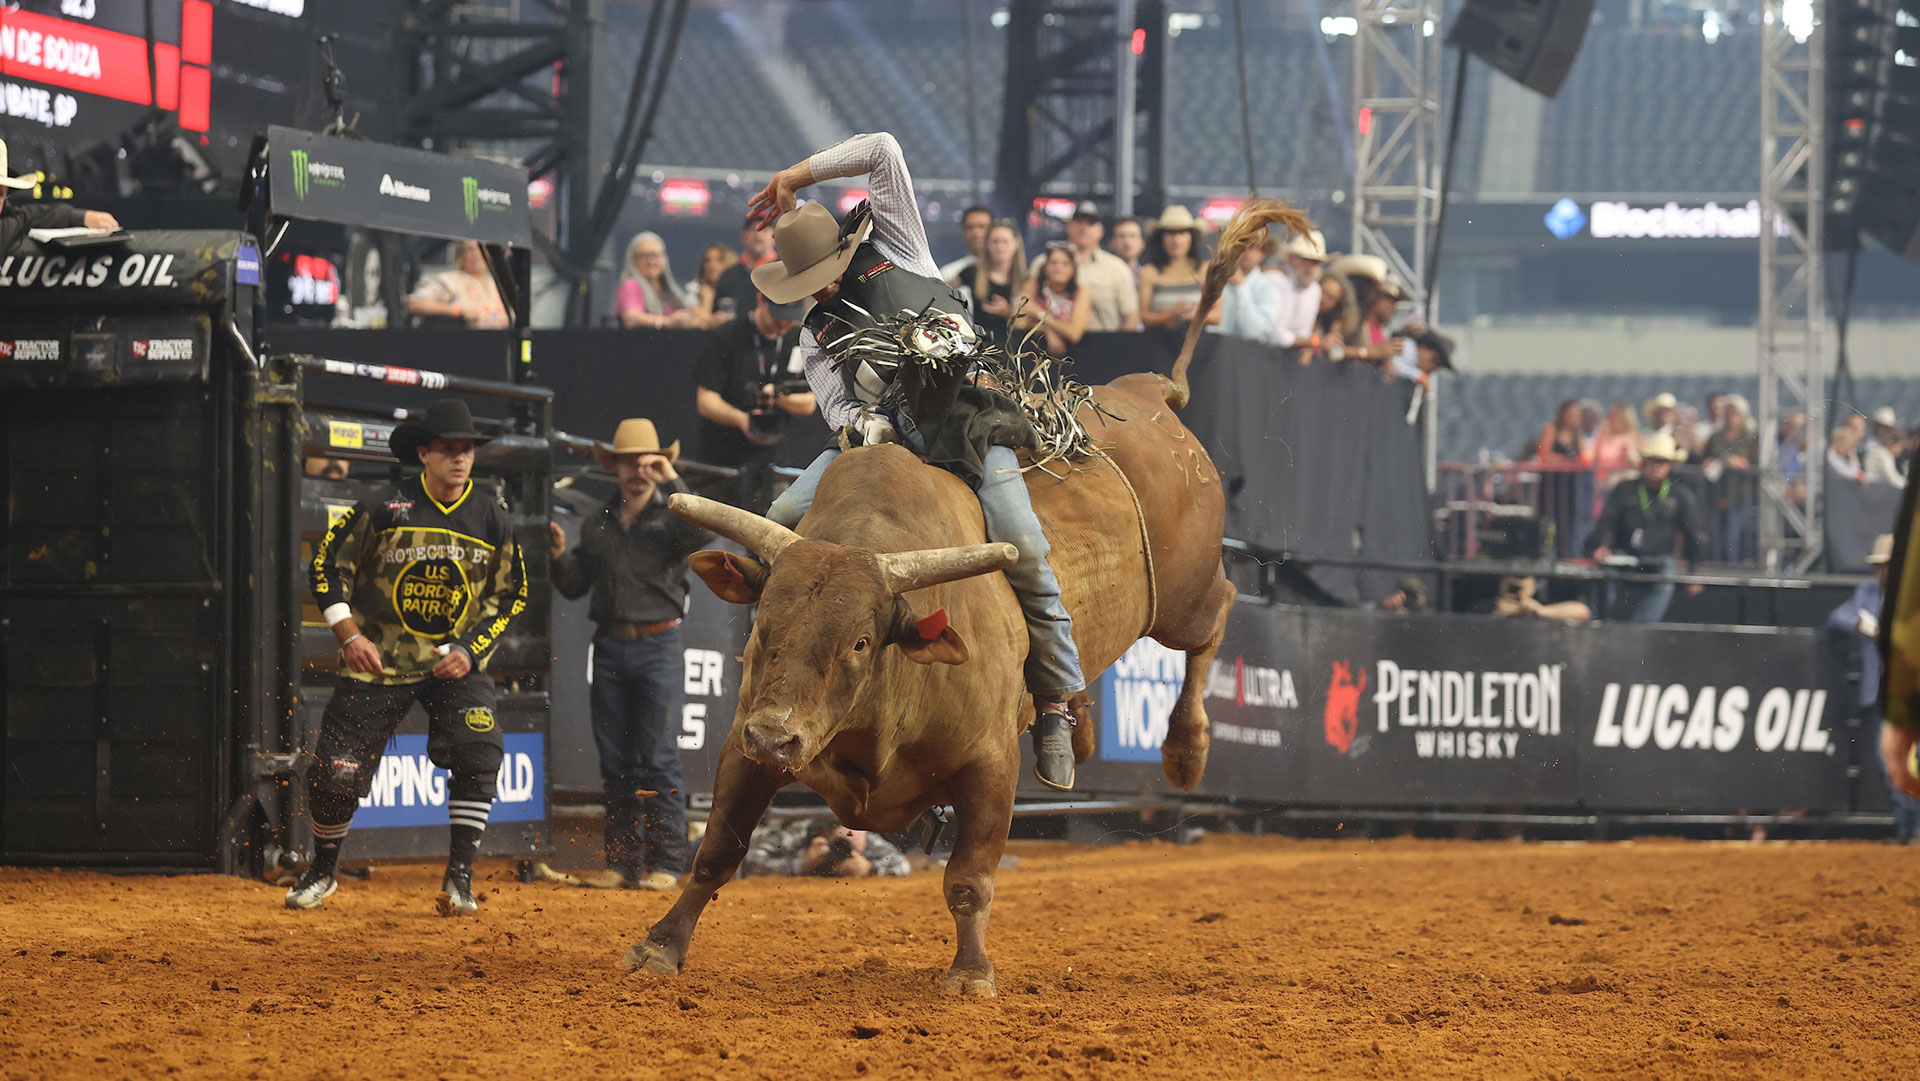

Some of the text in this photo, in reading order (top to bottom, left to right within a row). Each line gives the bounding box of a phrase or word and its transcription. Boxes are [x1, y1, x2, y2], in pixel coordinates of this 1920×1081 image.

[16, 28, 43, 67] DE
[43, 34, 101, 79] SOUZA
[0, 255, 113, 287] LUCAS
[1243, 664, 1298, 710] ULTRA
[1373, 659, 1561, 736] PENDLETON
[1593, 682, 1750, 752] LUCAS
[1415, 731, 1519, 759] WHISKY
[357, 755, 445, 808] MPING
